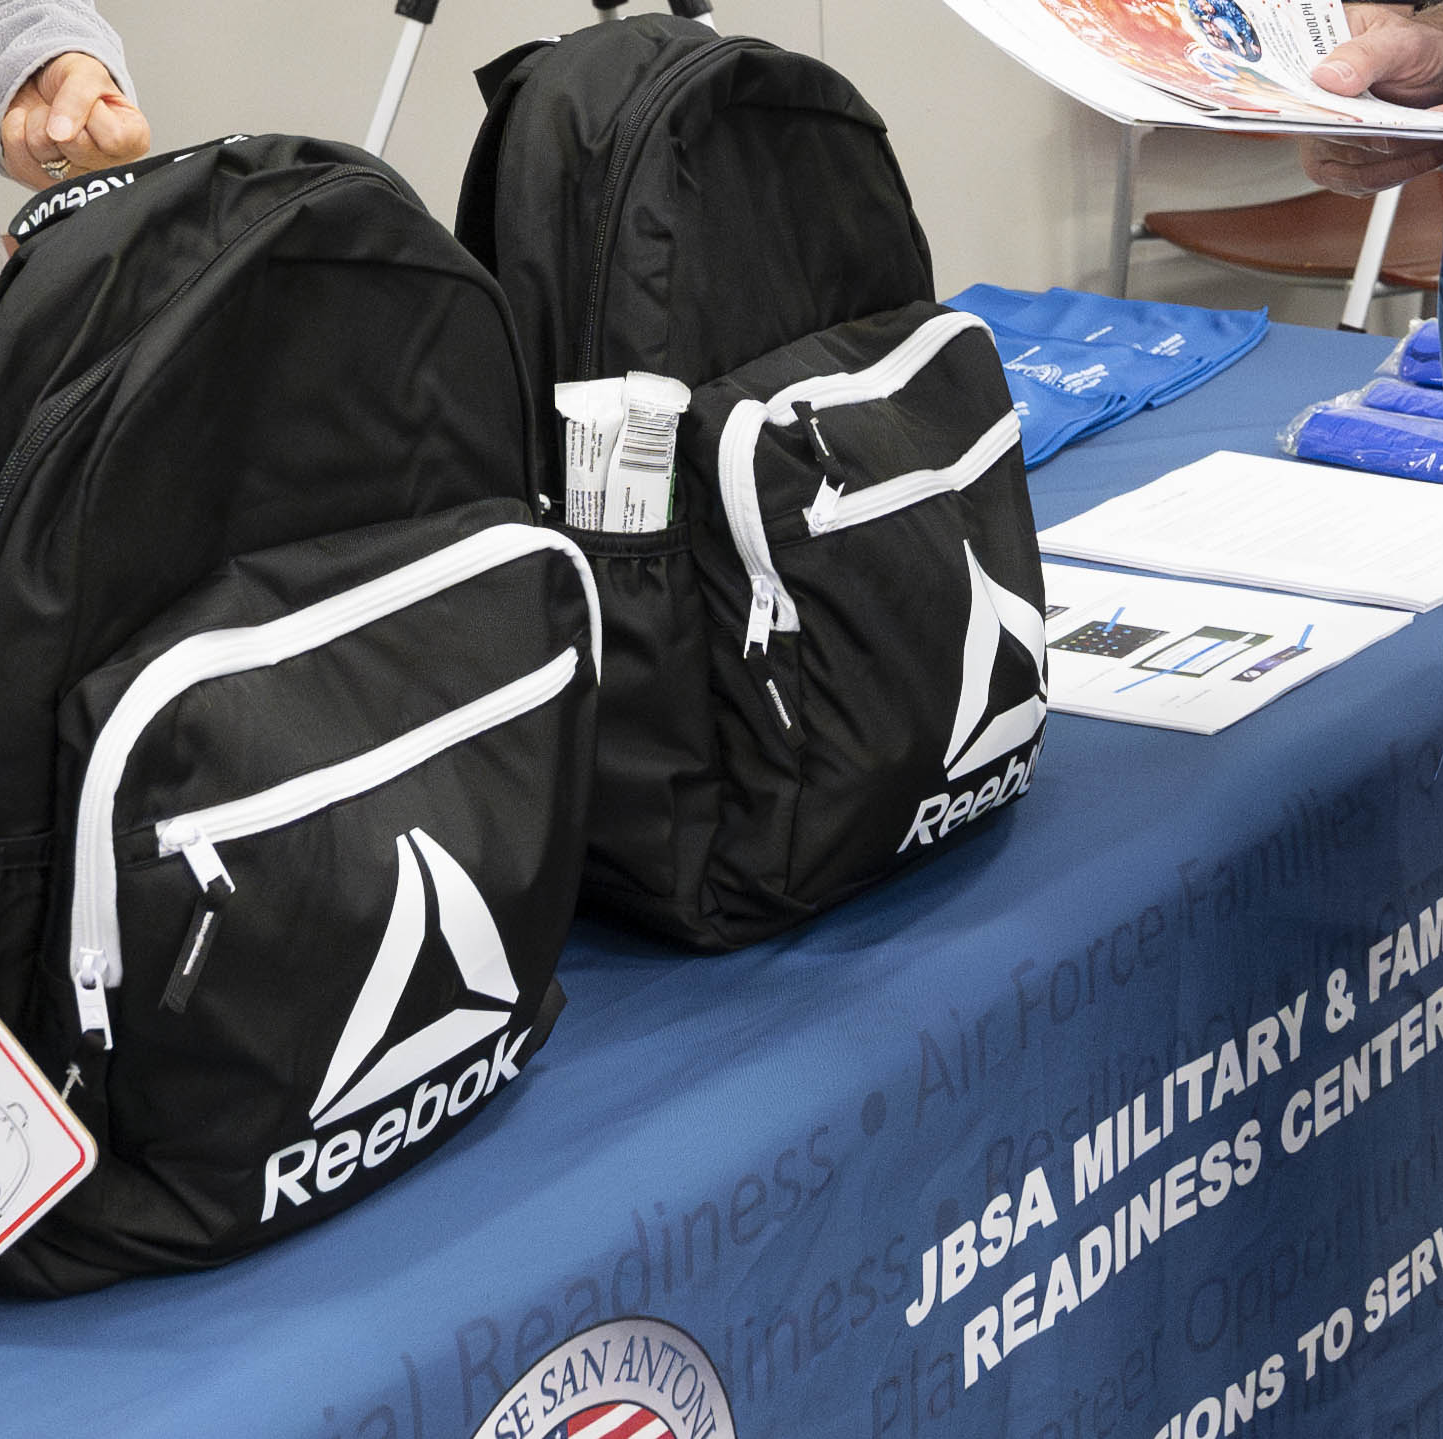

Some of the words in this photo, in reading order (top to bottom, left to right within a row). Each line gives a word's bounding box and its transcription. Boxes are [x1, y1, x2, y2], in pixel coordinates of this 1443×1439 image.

[1300, 2, 1327, 56] RANDOLPH
[896, 738, 1044, 855] Reebo
[916, 1004, 1003, 1127] Air
[1011, 900, 1167, 1050] Force
[1174, 776, 1380, 940] Families
[260, 1026, 532, 1225] Reebok
[905, 1166, 1058, 1327] JBSA
[1073, 989, 1309, 1206] MILITARY
[1324, 967, 1357, 1034] &
[736, 1232, 912, 1402] iness
[963, 1118, 1263, 1390] READINESS
[494, 1393, 535, 1439] SE
[540, 1340, 611, 1418] SAN
[1153, 1353, 1286, 1439] IONS
[1297, 1307, 1354, 1382] TO
